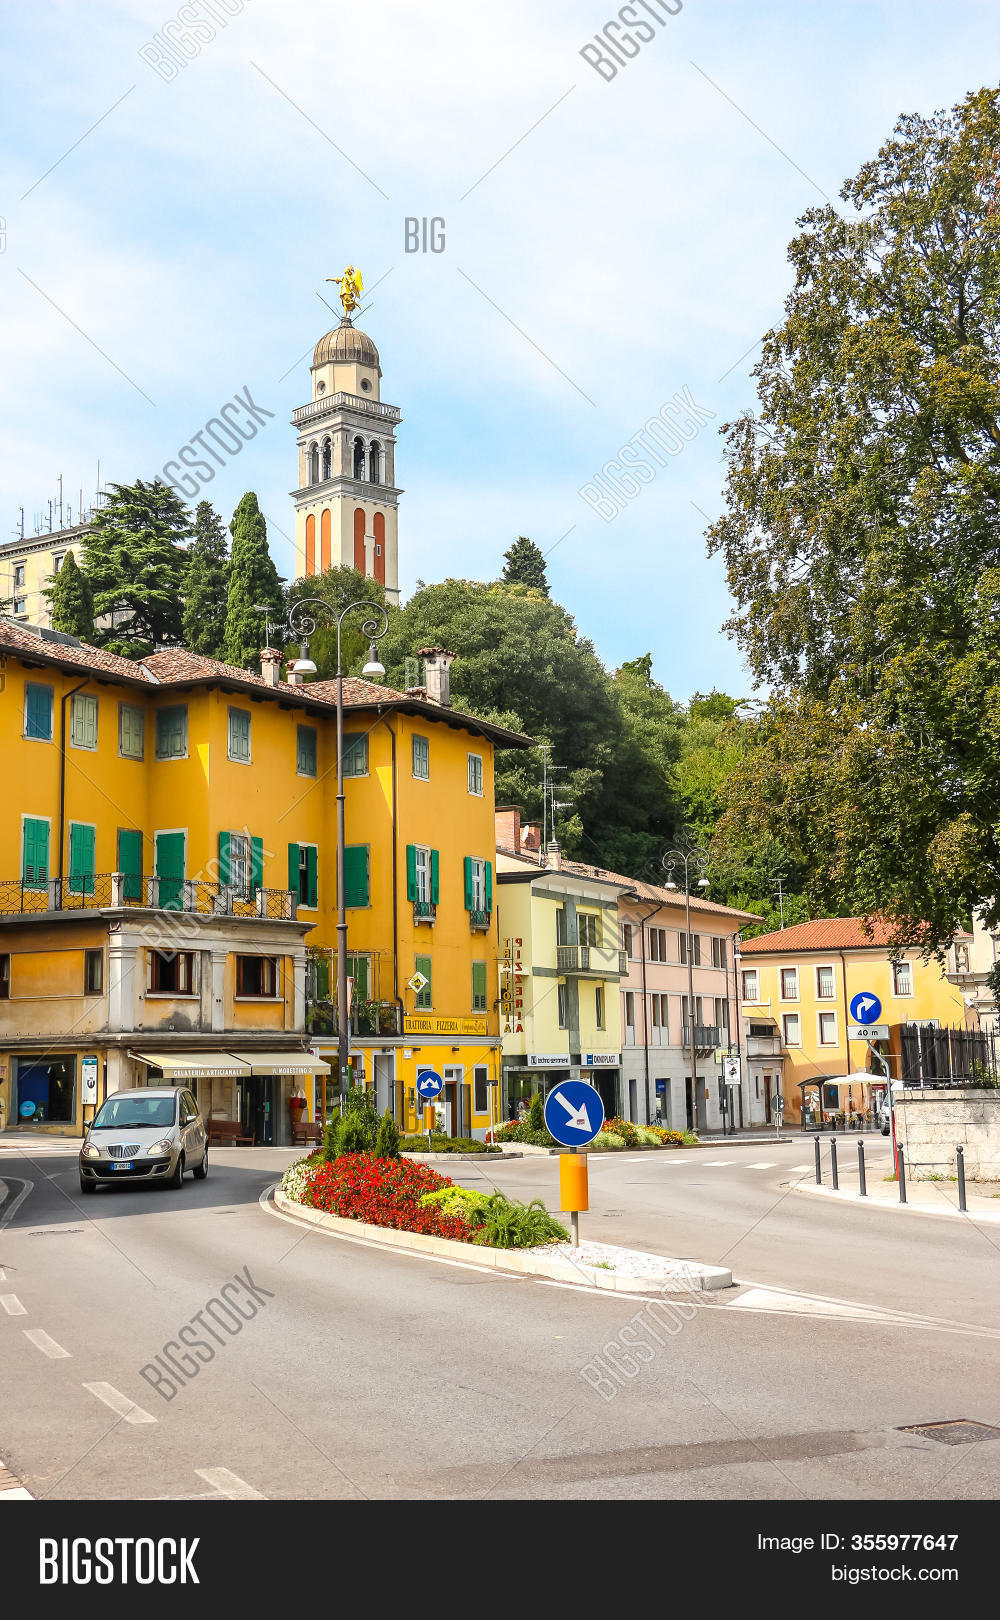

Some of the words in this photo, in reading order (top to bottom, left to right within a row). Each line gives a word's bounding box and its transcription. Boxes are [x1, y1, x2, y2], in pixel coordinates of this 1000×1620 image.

[406, 1019, 431, 1030] TRATTORIA
[437, 1021, 459, 1031] PIZZERIA
[173, 1069, 205, 1077] GELATERIA
